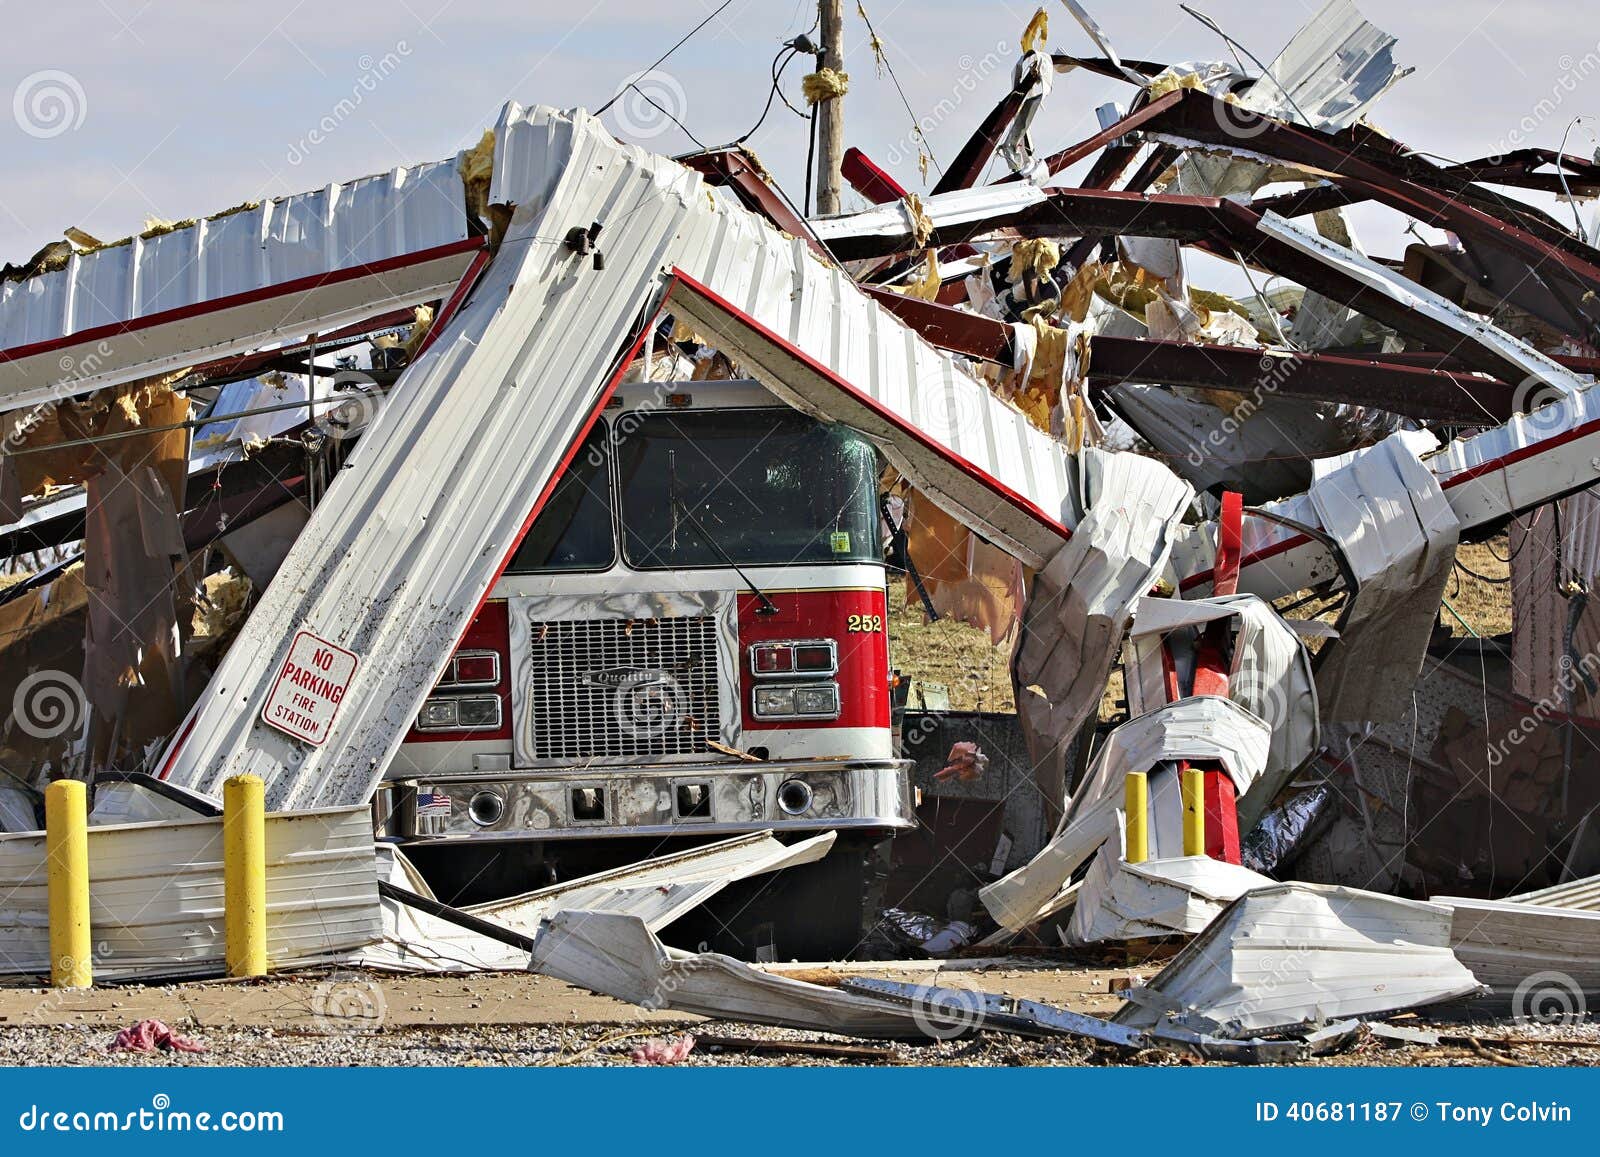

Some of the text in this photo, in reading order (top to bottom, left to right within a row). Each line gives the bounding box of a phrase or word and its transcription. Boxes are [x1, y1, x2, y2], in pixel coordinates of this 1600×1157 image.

[848, 614, 882, 632] 252
[311, 648, 333, 671] NO
[282, 662, 343, 704] PARKING
[292, 693, 317, 713] FIRE
[274, 705, 320, 734] STATION
